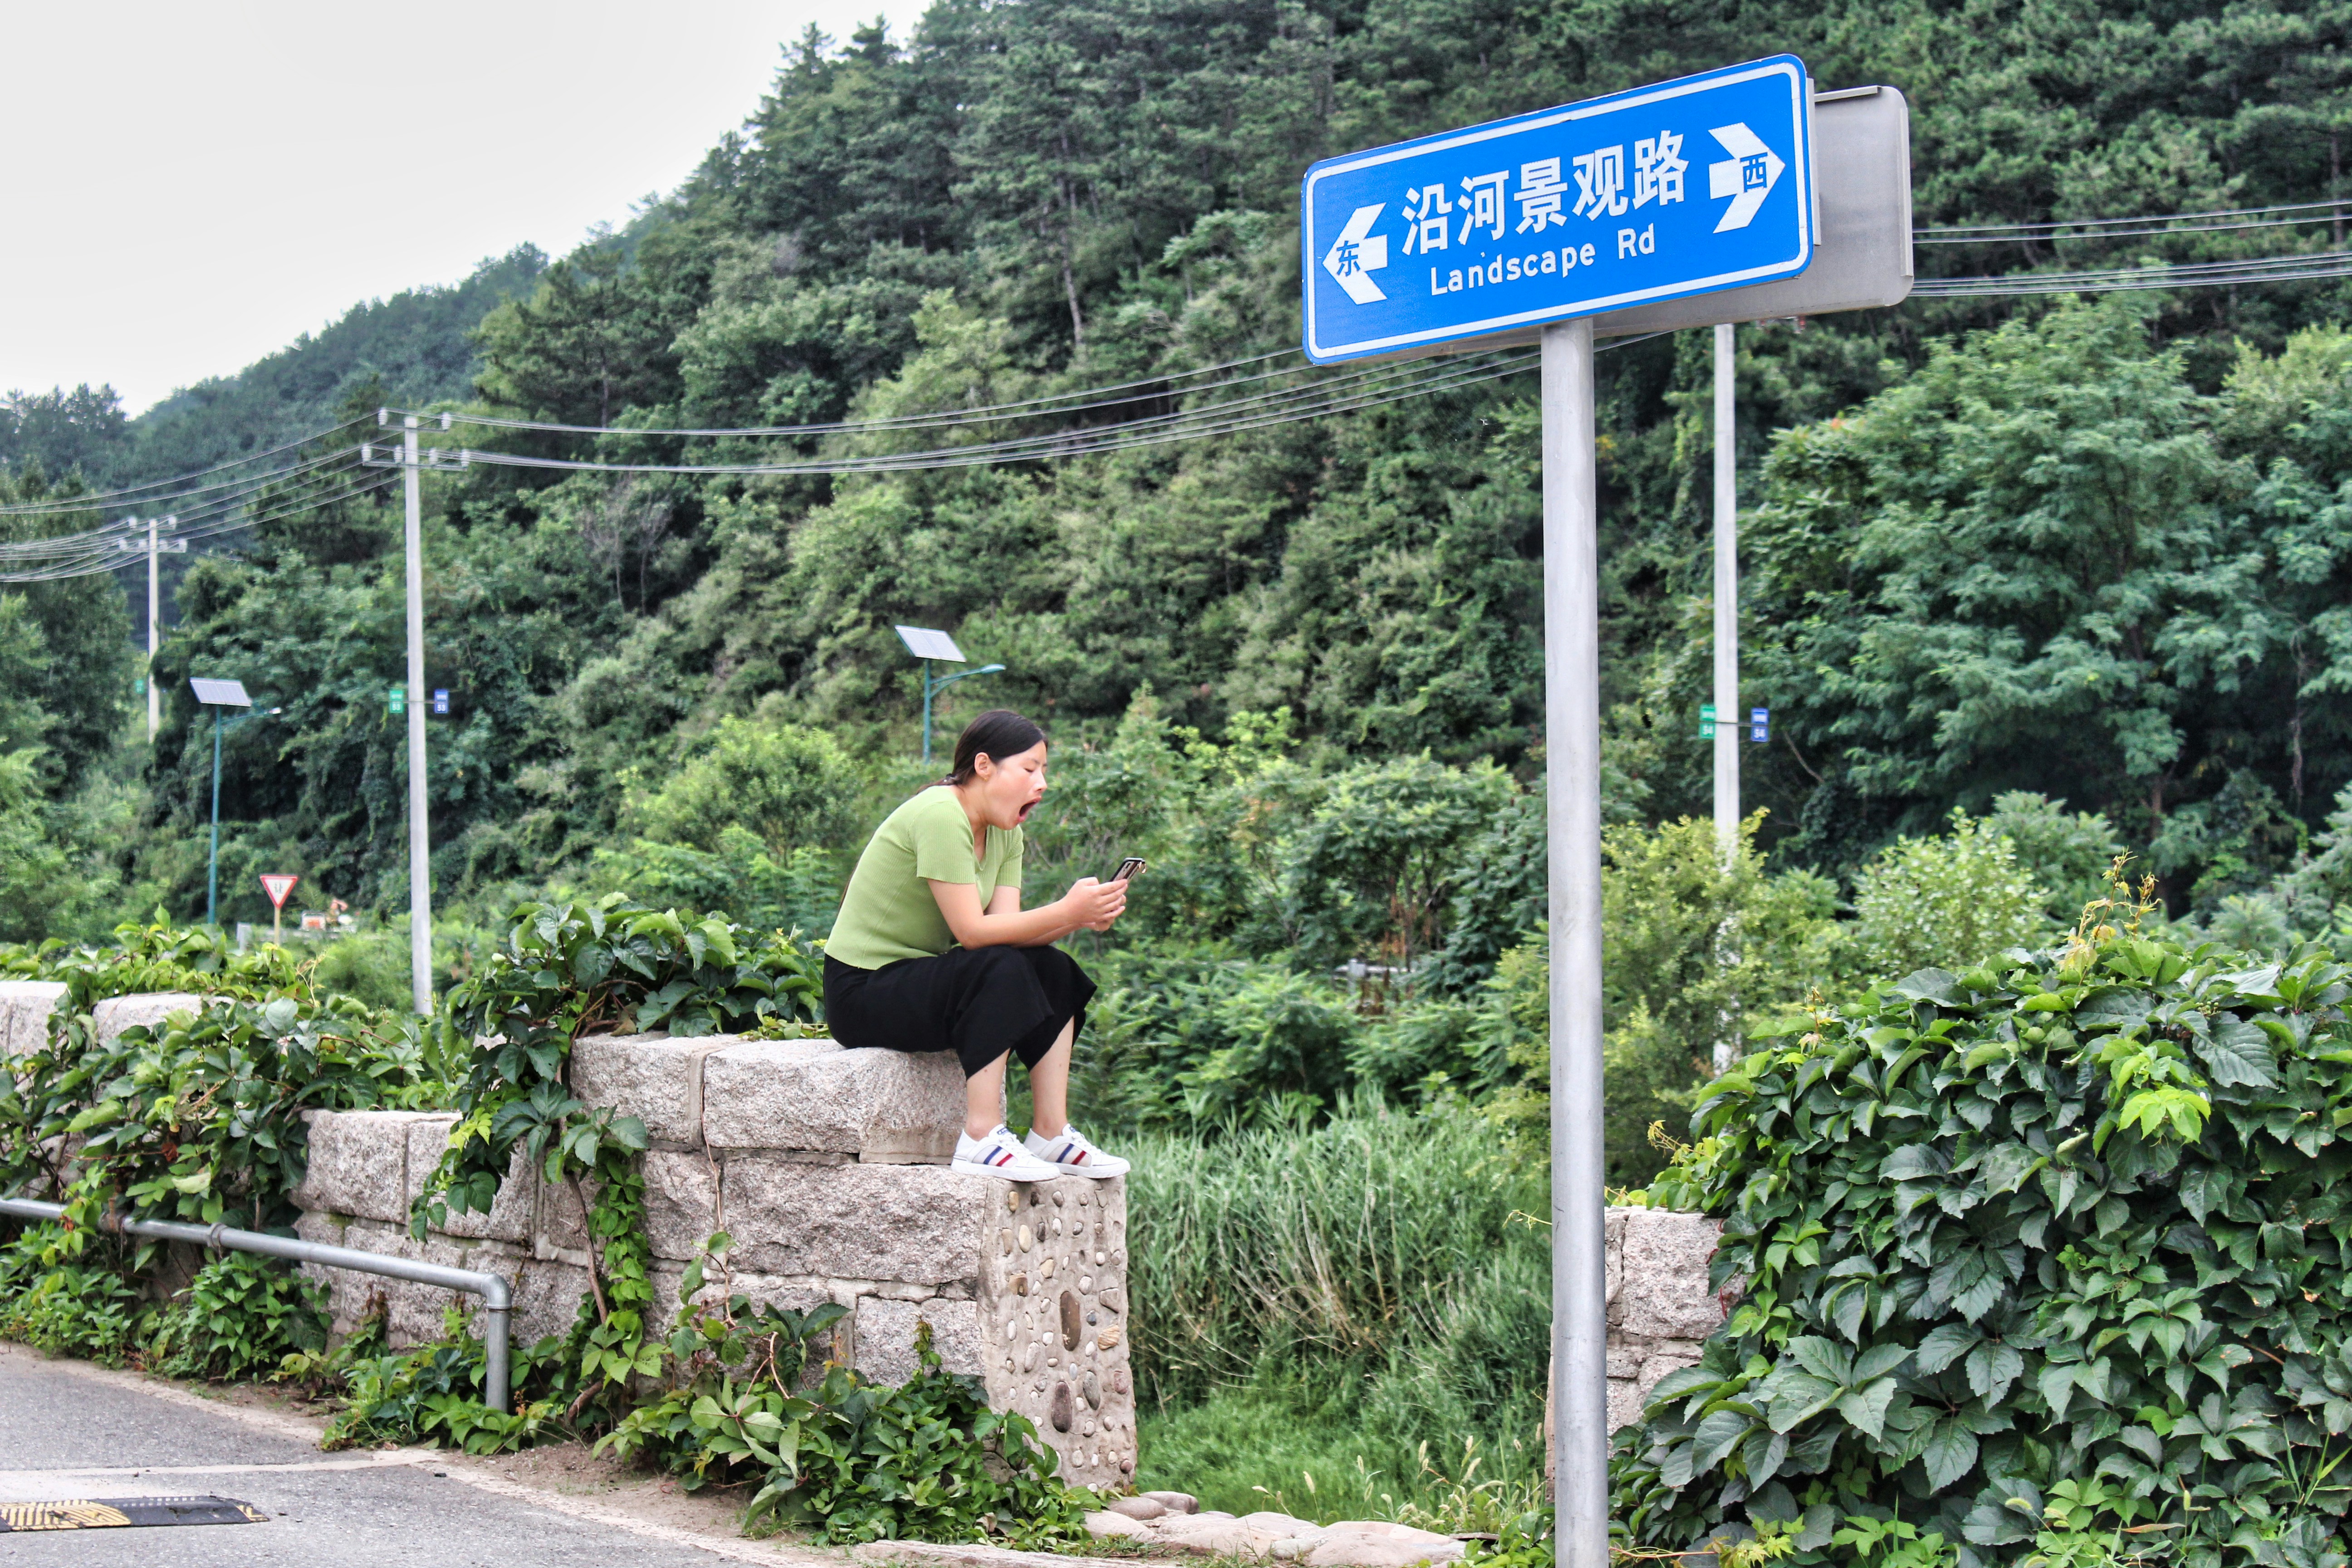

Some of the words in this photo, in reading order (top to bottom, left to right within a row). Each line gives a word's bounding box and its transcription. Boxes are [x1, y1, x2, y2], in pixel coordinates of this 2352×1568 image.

[1740, 152, 1768, 192] 西
[1401, 130, 1689, 255] 沿河景观路
[1336, 240, 1361, 277] 东
[1430, 242, 1595, 296] Landscape
[1617, 223, 1655, 260] Rd
[273, 882, 284, 894] 让
